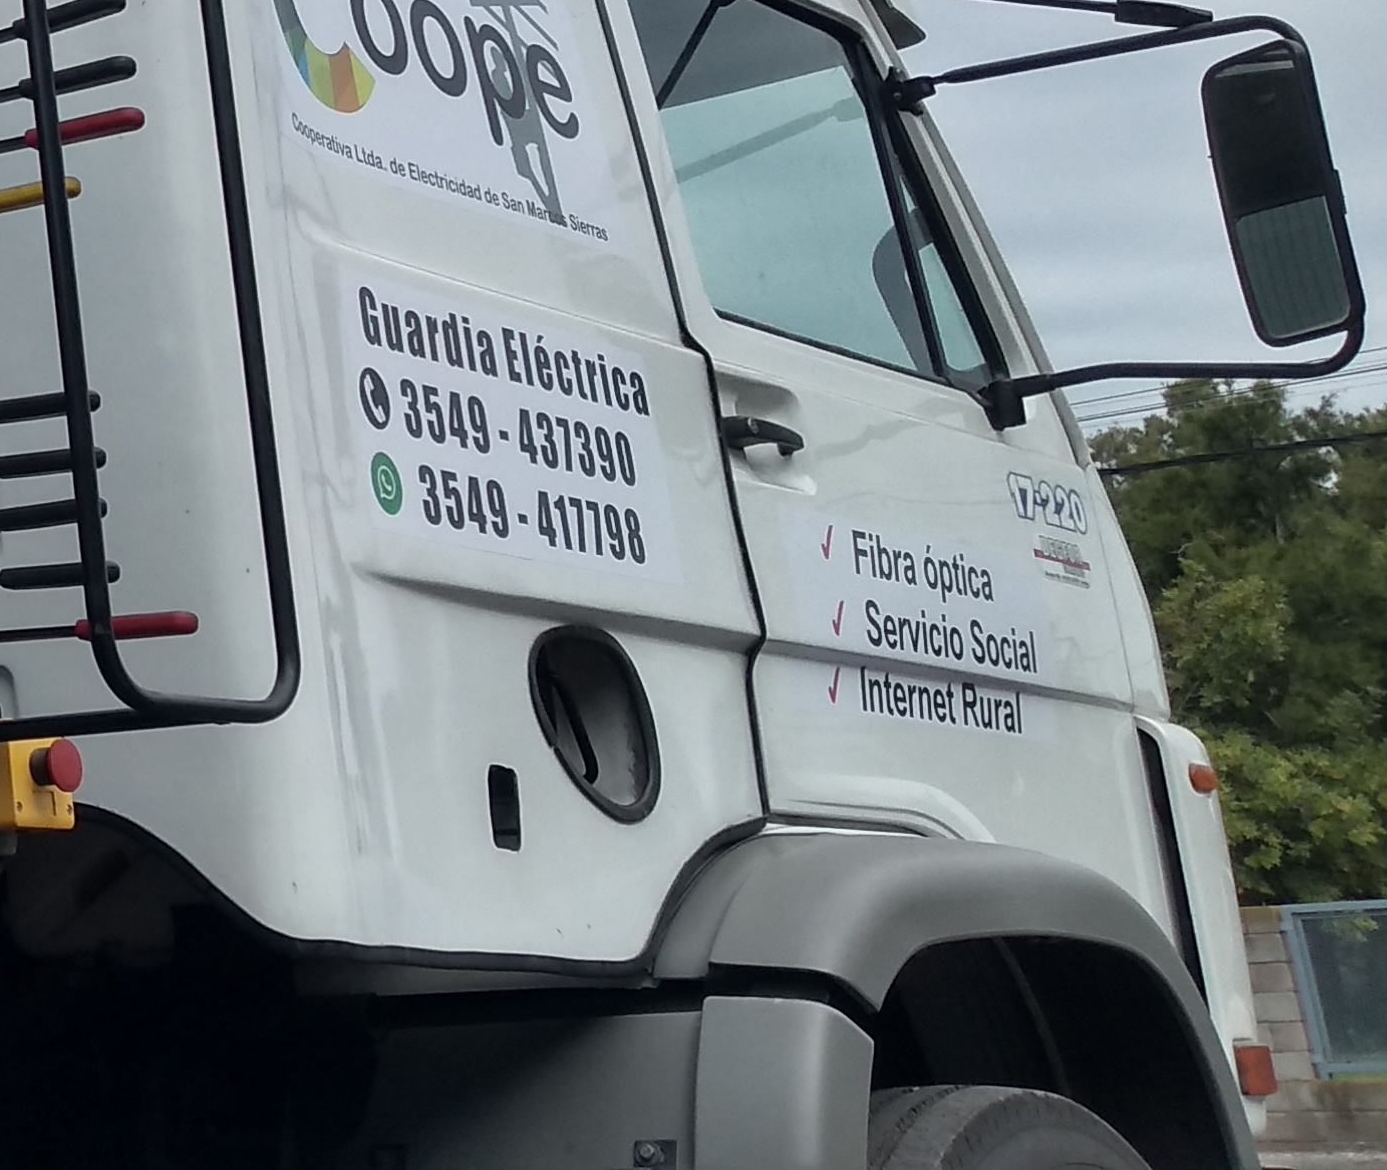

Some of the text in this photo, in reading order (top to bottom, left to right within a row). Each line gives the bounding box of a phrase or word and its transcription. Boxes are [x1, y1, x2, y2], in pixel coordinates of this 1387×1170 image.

[291, 112, 609, 241] Cooperativa Ltda. de Electricidad de San Marcos Sierras
[359, 286, 650, 417] Guardia Eléctrica
[400, 378, 491, 454] 3549
[519, 408, 636, 487] 437390
[418, 464, 509, 538] 3549
[537, 490, 646, 564] 417798
[1007, 471, 1088, 535] 17-220
[851, 529, 917, 586] Fibra
[923, 545, 994, 603] óptica
[865, 599, 1038, 673] Servicio Social
[860, 666, 1023, 734] Internet Rural
